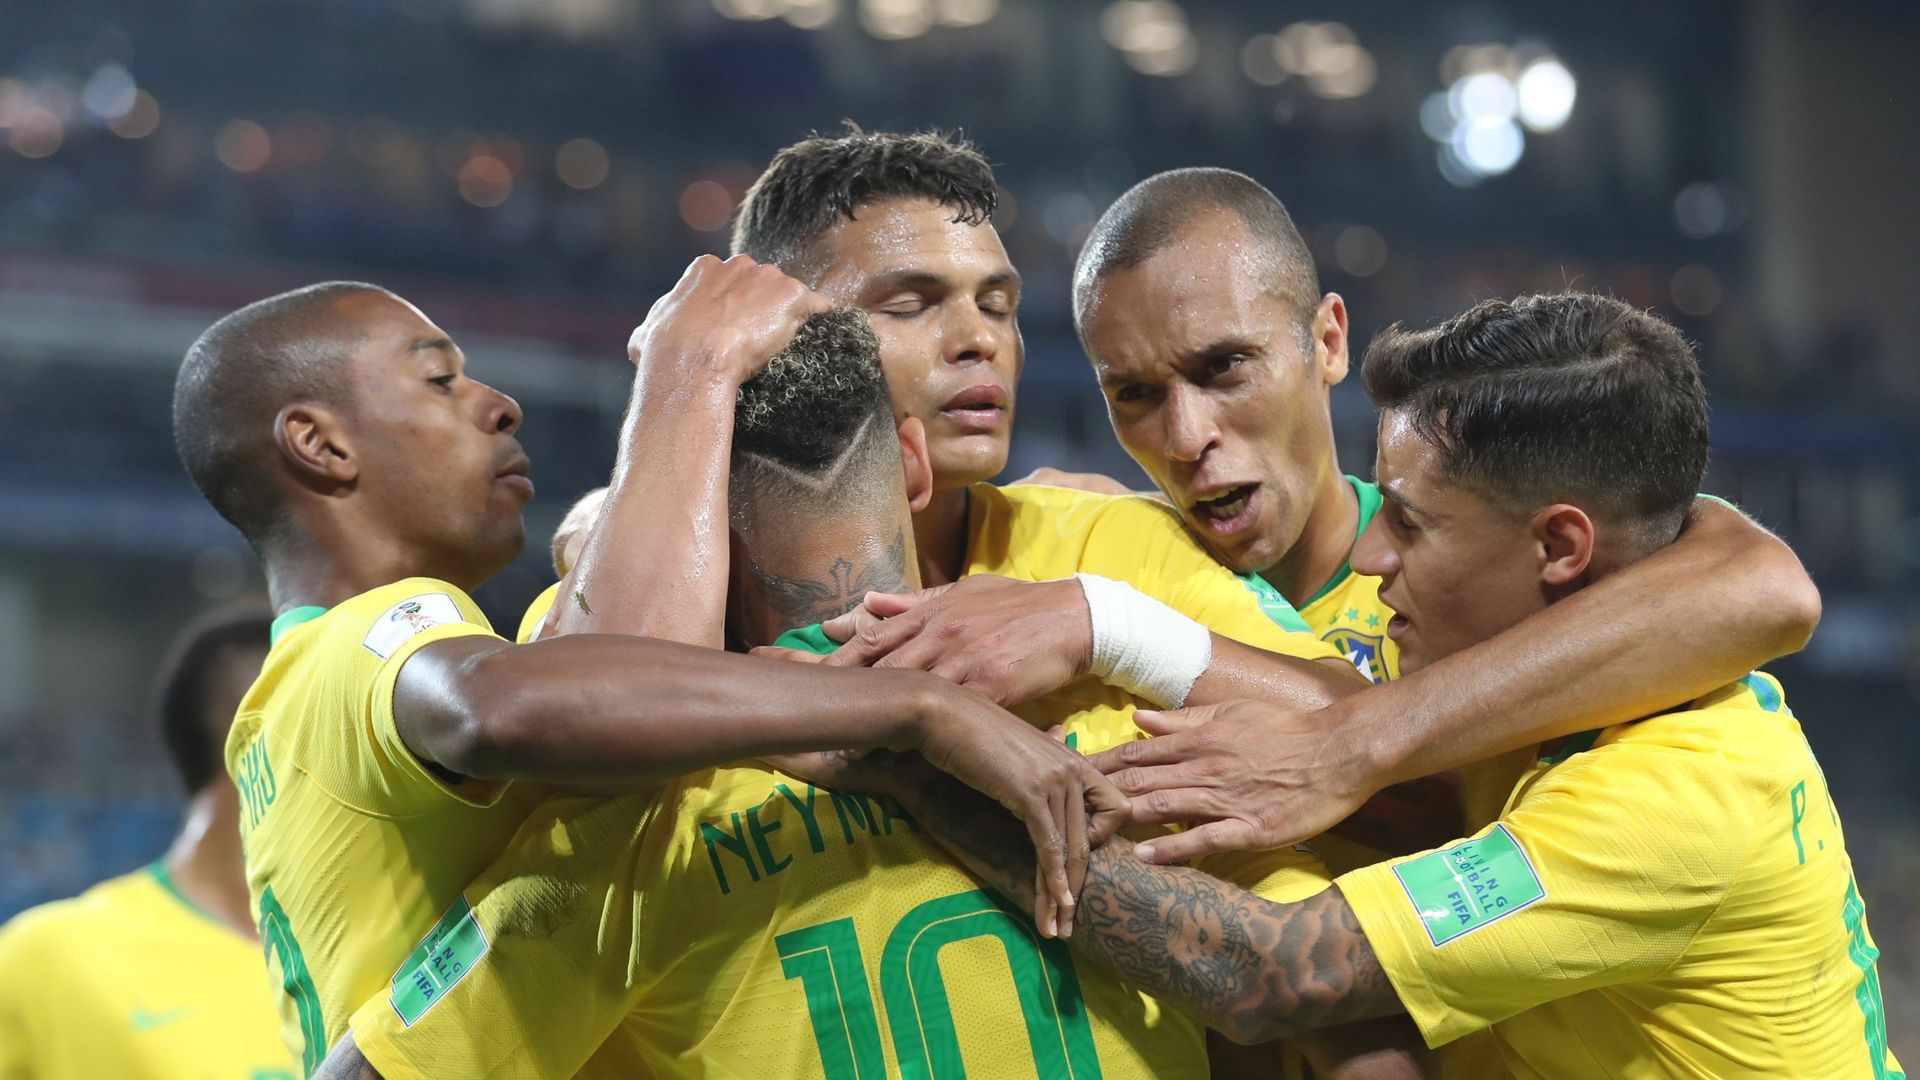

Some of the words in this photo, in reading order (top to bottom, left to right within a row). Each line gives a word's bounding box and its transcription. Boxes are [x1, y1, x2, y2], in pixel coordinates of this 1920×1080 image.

[700, 781, 919, 895] NEYMA
[1447, 891, 1473, 925] FIFA
[1463, 846, 1508, 908] LIVING
[412, 969, 436, 1001] FIFA
[774, 887, 1103, 1080] 10
